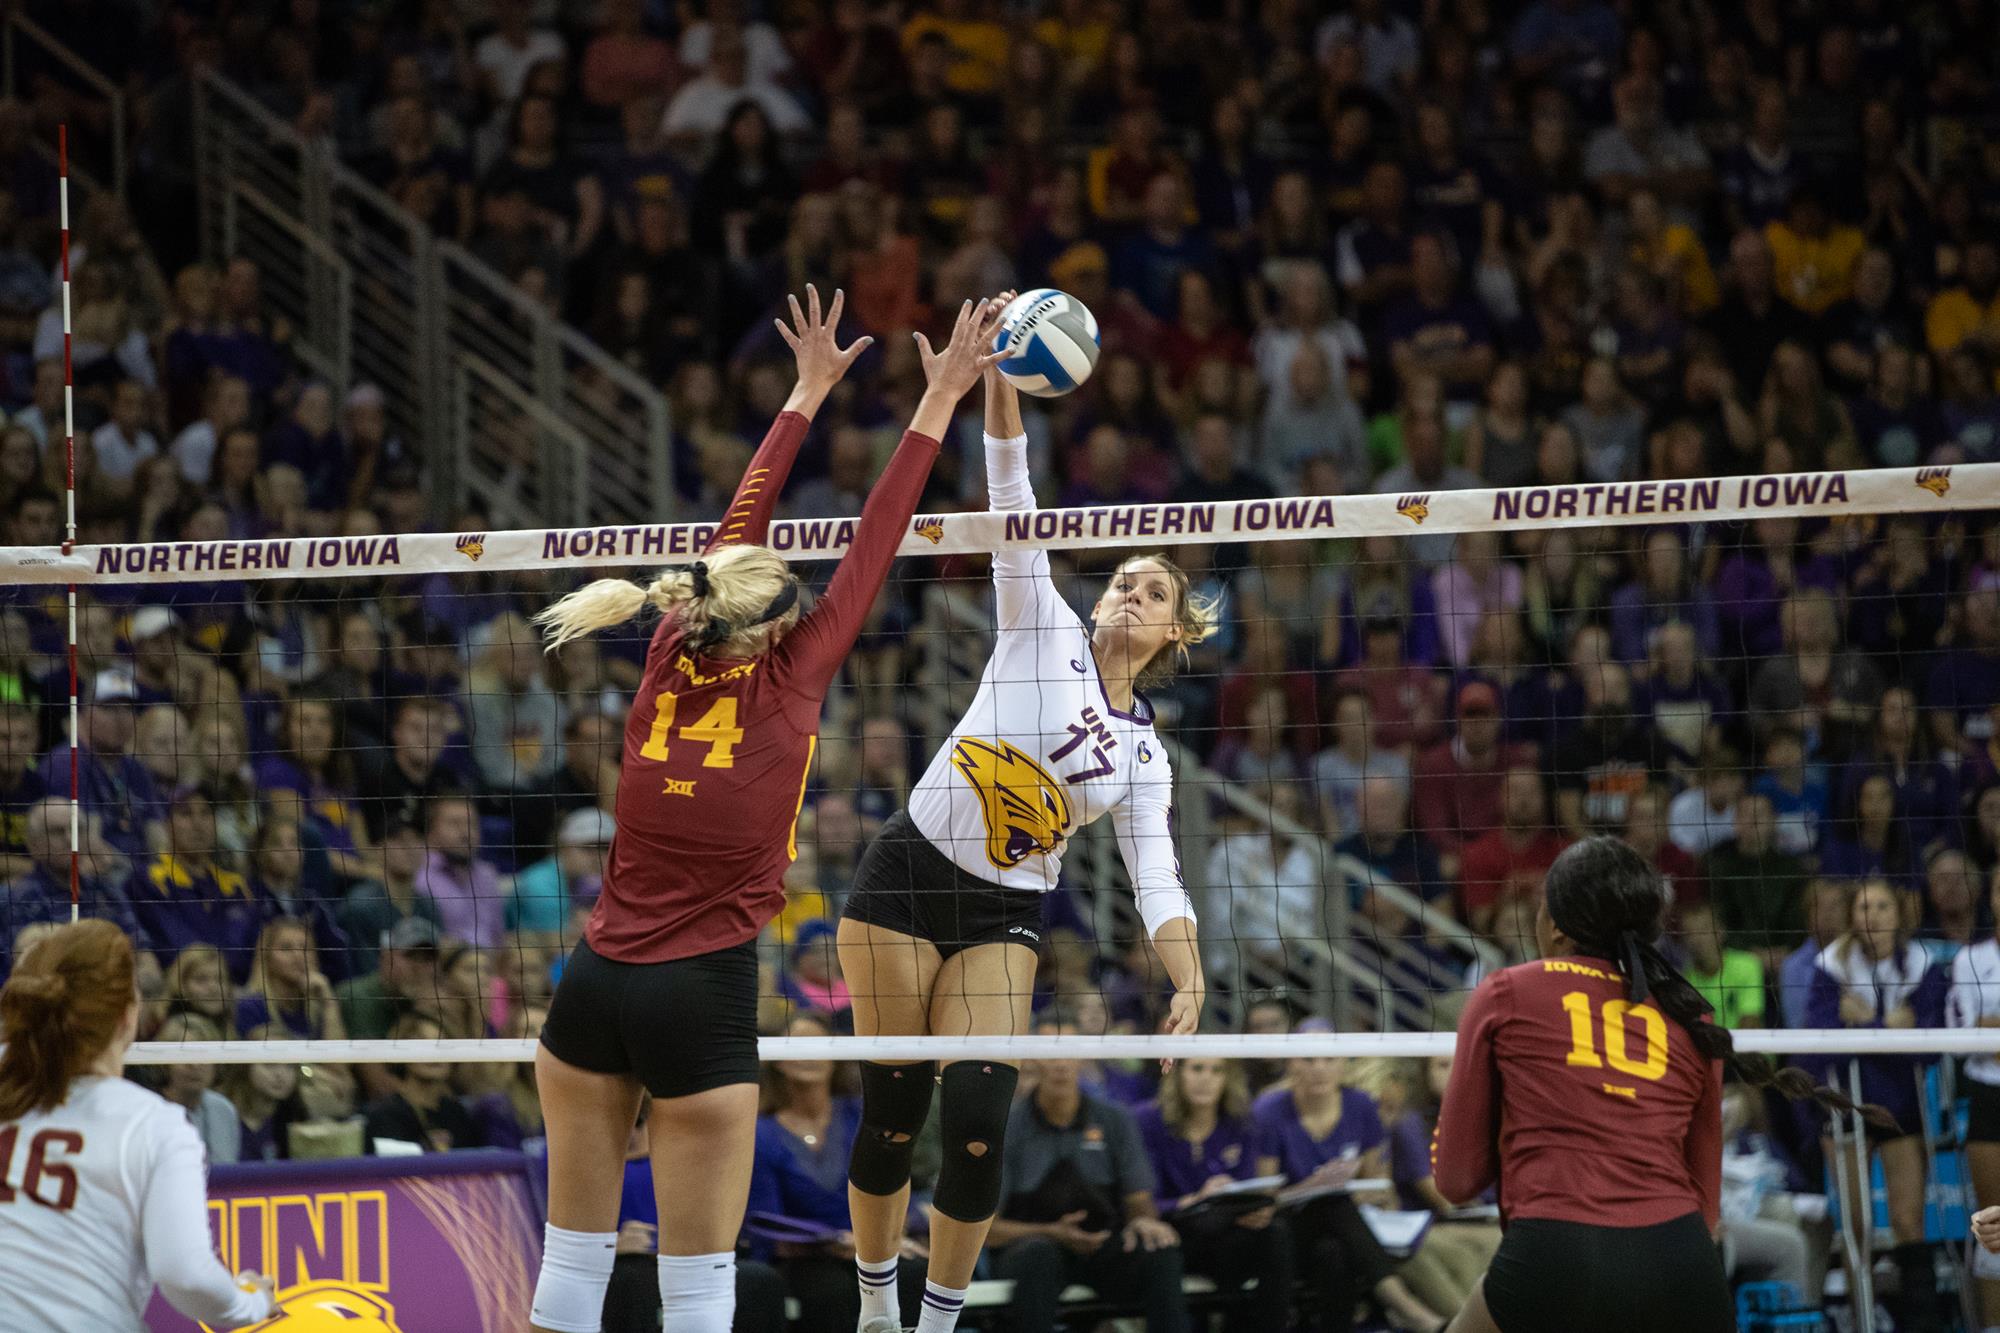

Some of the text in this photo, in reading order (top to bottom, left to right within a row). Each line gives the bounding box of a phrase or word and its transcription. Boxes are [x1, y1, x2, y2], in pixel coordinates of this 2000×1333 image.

[1397, 495, 1430, 511] UNI
[1493, 473, 1849, 520] NORTHERN IOWA
[542, 520, 855, 559] NORTHER OWA
[1005, 499, 1334, 541] NORTHERN IOWA
[96, 537, 400, 574] NORTHERN IOWA
[456, 534, 486, 548] UNI
[640, 692, 744, 768] 14
[1081, 706, 1118, 751] UNI
[1048, 723, 1116, 784] 17
[662, 778, 697, 797] XII
[1544, 961, 1606, 979] IOWA
[1562, 991, 1669, 1081] 10
